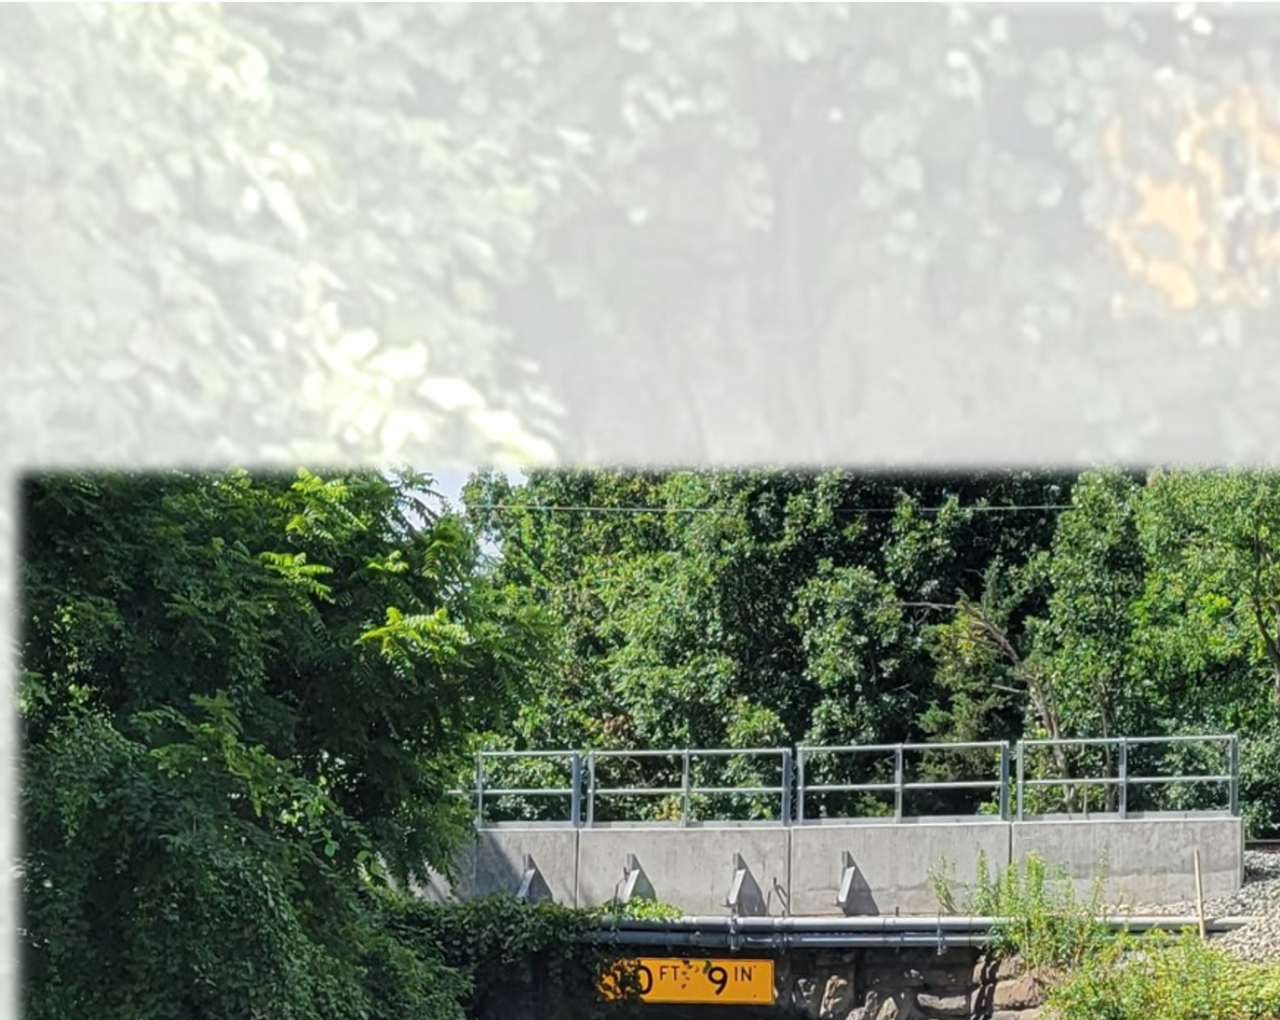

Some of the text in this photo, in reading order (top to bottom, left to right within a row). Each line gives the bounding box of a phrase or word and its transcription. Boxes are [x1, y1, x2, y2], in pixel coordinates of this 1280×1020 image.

[659, 966, 680, 981] FT
[707, 966, 728, 995] 9
[734, 966, 752, 981] IN
